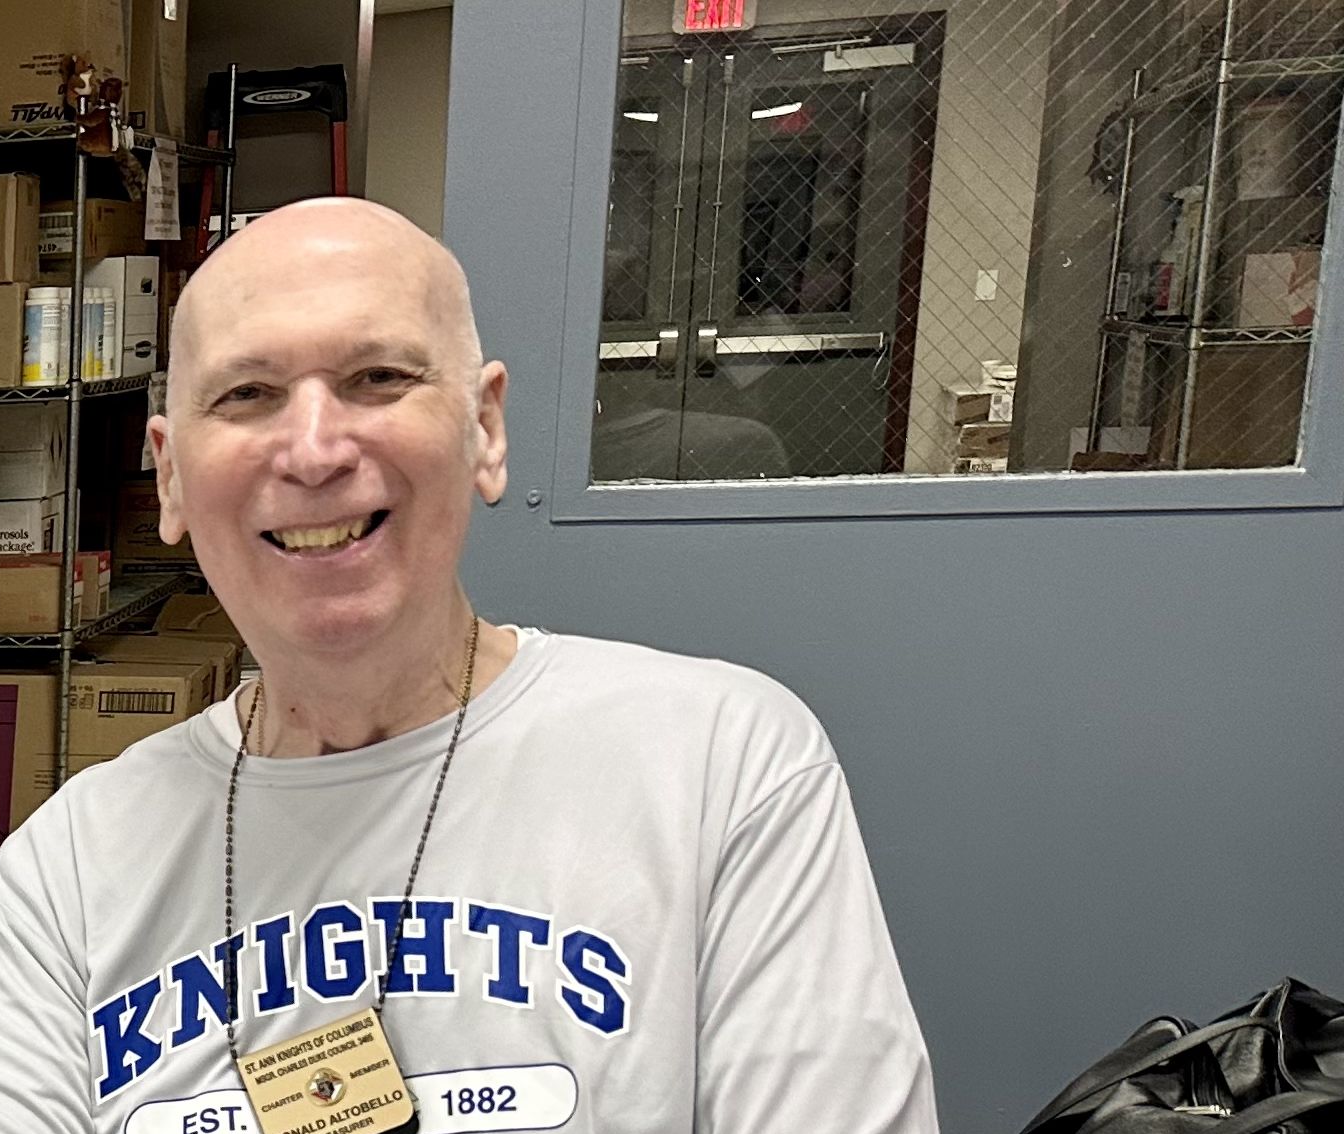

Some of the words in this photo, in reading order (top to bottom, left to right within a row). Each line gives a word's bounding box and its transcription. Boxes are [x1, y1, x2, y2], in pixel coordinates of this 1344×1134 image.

[90, 897, 632, 1100] KNIGHTS
[244, 1064, 258, 1075] ST.
[259, 1056, 276, 1069] ANN
[277, 1040, 313, 1065] KNIGHTS
[313, 1035, 326, 1048] OF
[326, 1017, 375, 1042] COLUMBUS
[278, 1060, 308, 1077] CHARLES
[309, 1053, 327, 1065] DUKE
[328, 1042, 357, 1058] COUNCIL
[261, 1092, 304, 1113] CHARTER
[350, 1059, 390, 1079] MEMBER
[330, 1090, 404, 1126] ALTOBELLO
[440, 1085, 517, 1117] 1882
